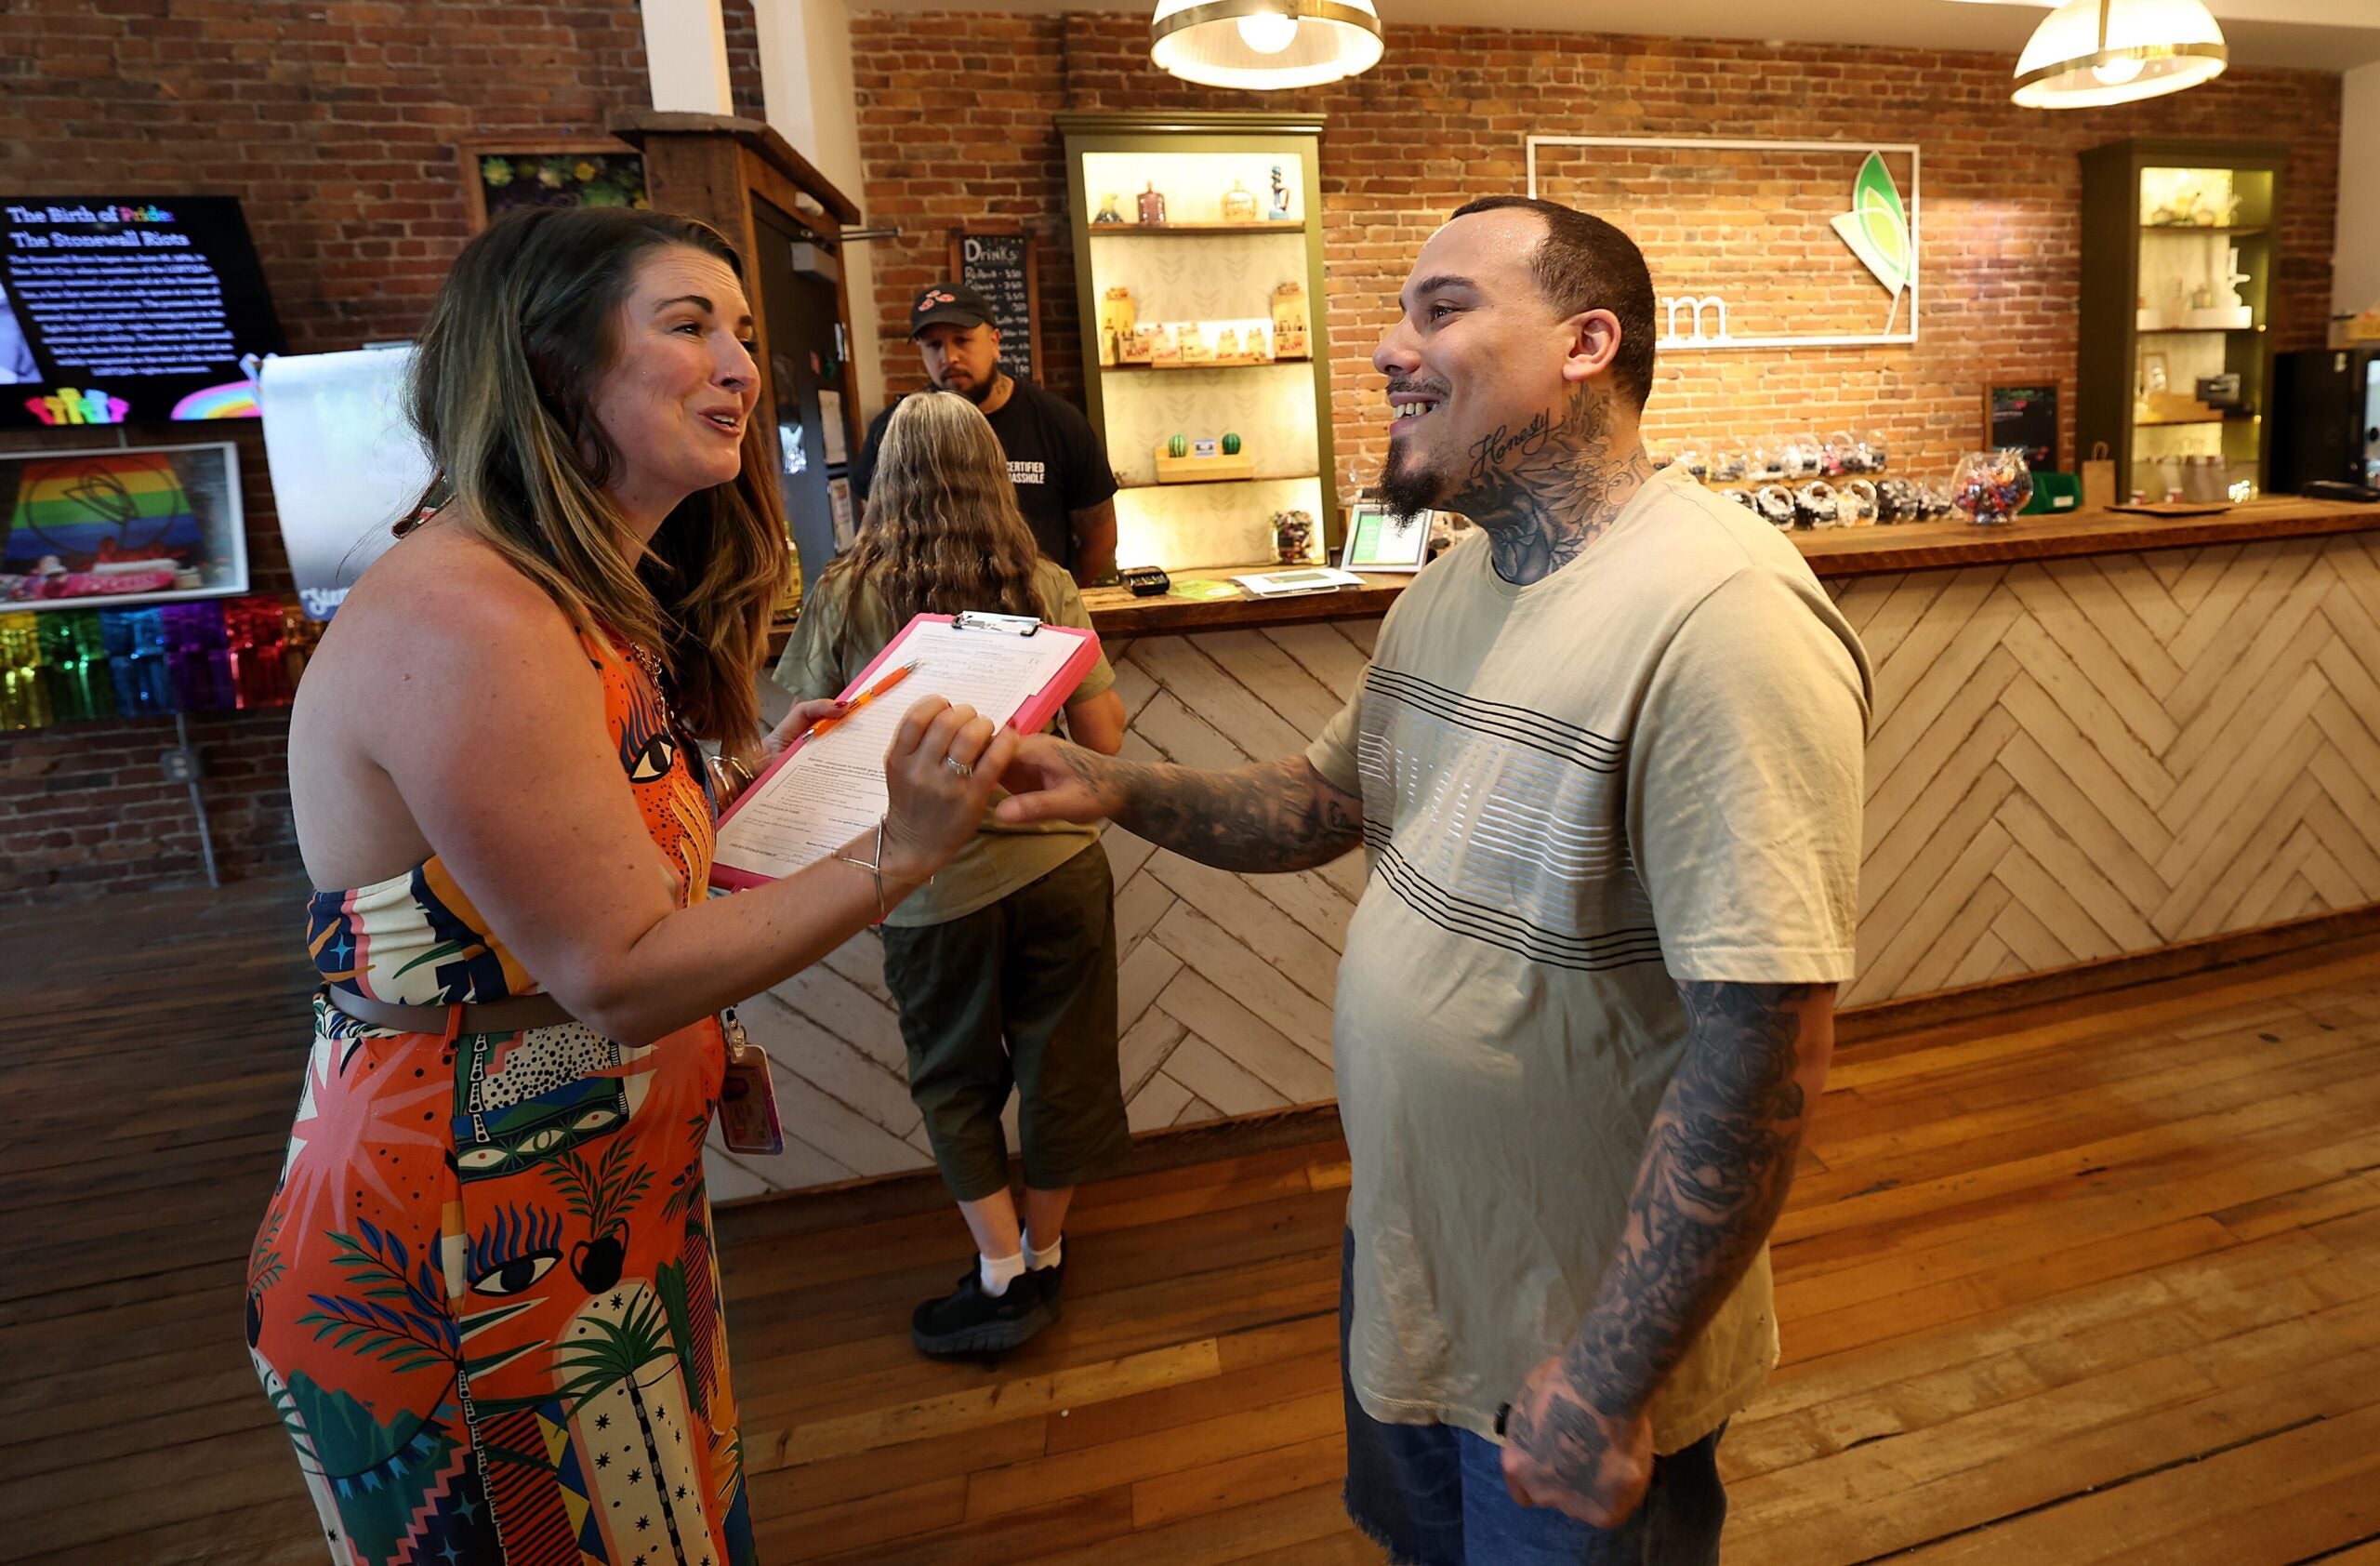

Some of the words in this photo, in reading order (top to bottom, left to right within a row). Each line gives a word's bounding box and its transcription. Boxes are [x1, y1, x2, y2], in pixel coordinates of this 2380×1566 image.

[5, 205, 46, 223] The
[46, 205, 98, 223] Birth
[97, 205, 119, 223] of
[8, 231, 49, 248] The
[50, 229, 141, 247] Stonewall
[140, 230, 191, 246] Riots
[1468, 406, 1567, 479] Honesty
[1009, 472, 1045, 484] ASSHOLE
